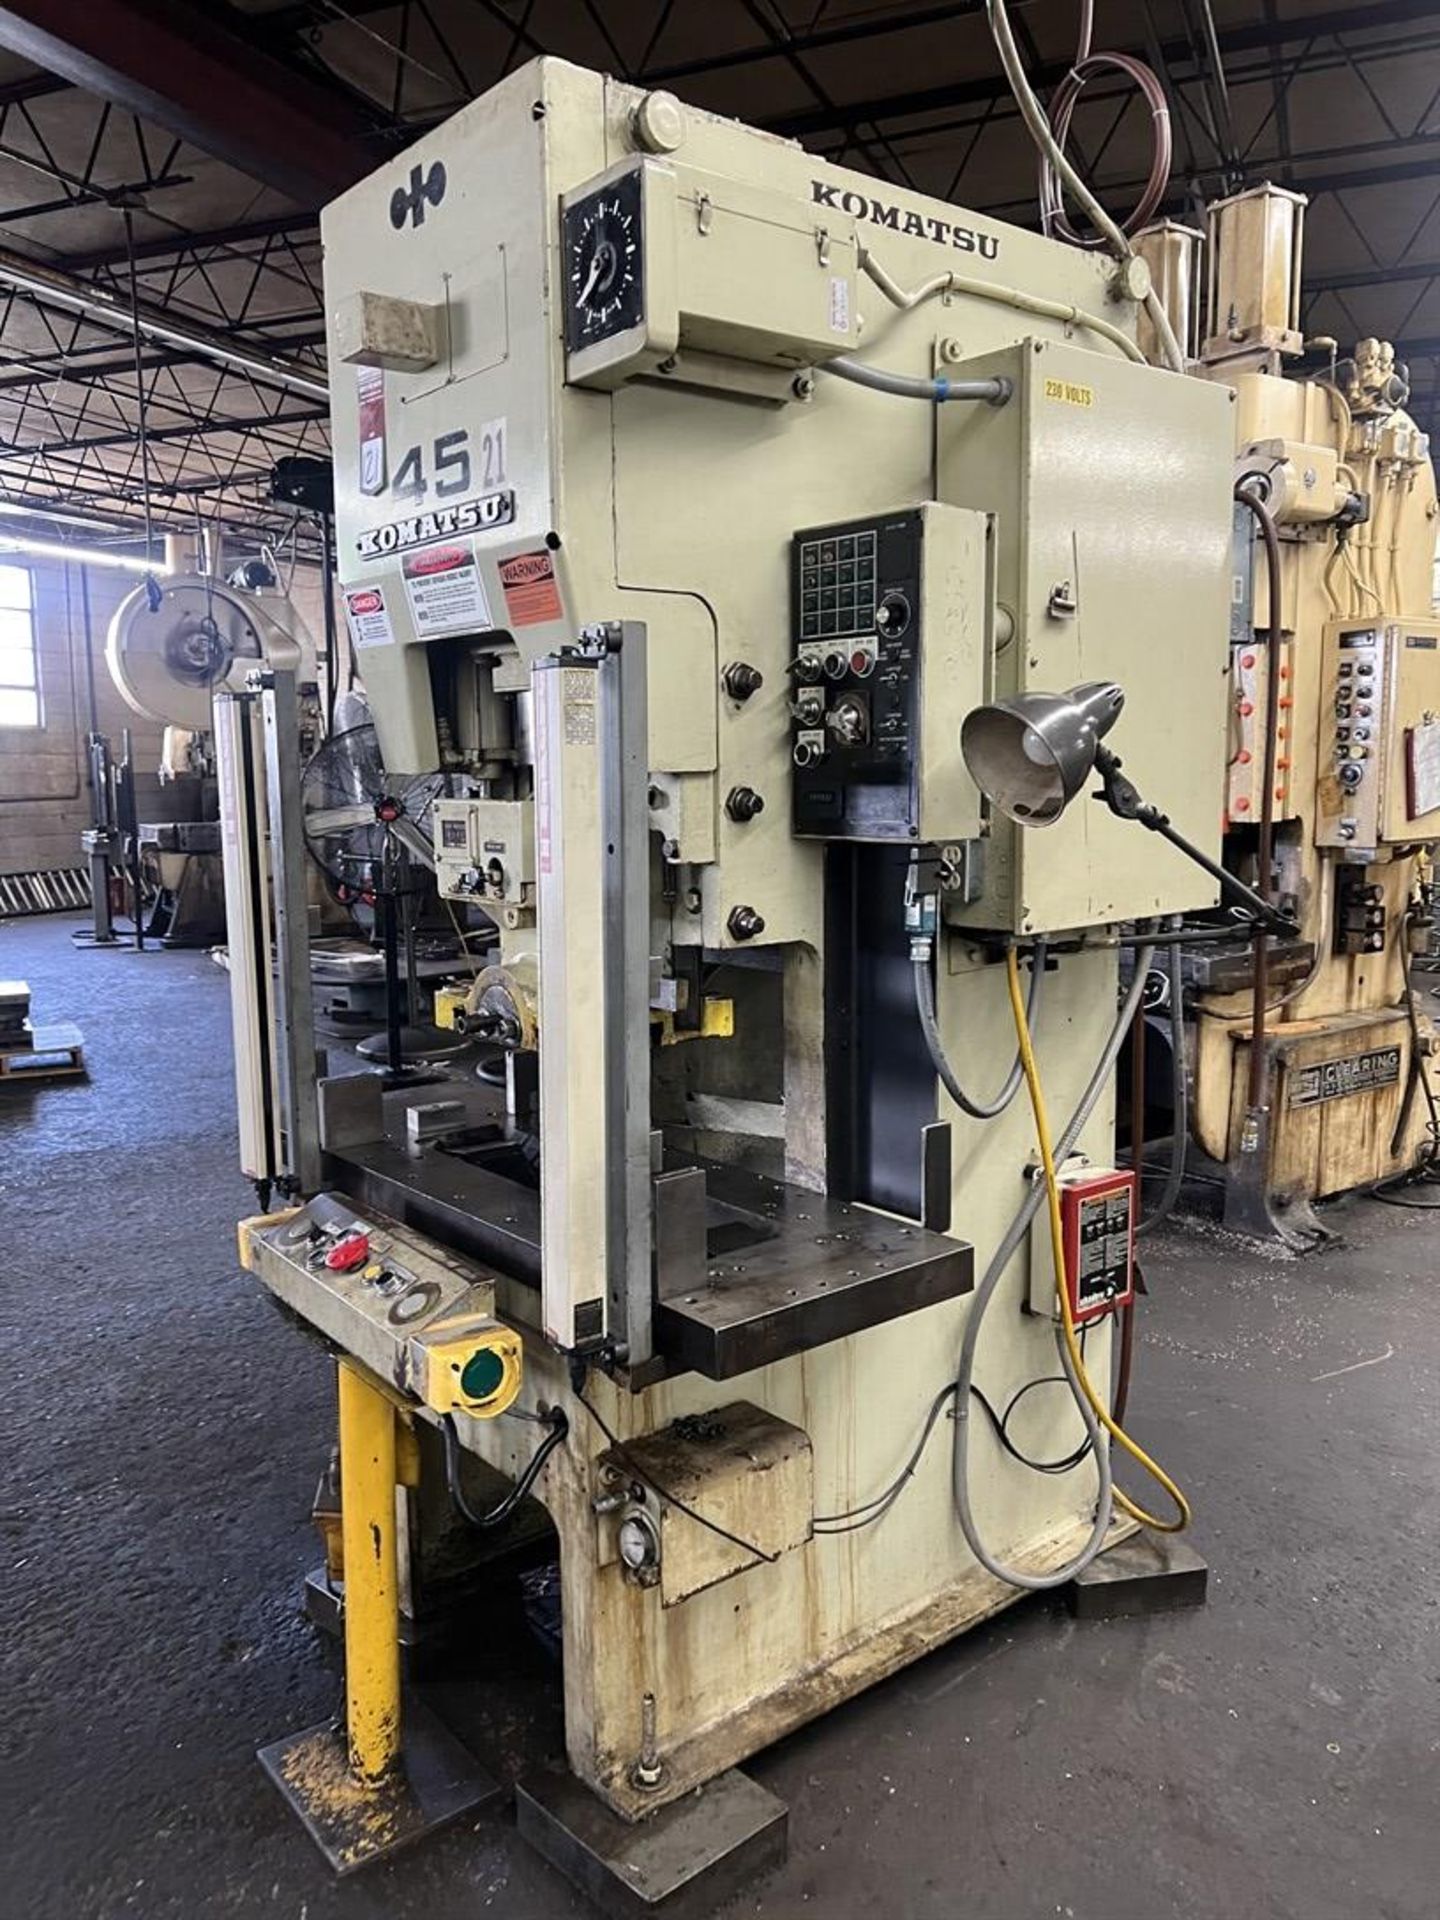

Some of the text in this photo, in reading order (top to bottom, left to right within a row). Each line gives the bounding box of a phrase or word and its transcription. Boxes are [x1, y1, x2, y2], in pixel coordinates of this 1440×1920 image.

[812, 181, 999, 260] KOMATSU
[1046, 380, 1091, 405] 230 VOLTS
[392, 429, 471, 506] 45
[482, 428, 506, 488] 21
[360, 494, 501, 554] KOMATSU
[503, 558, 549, 581] WARNING
[1325, 1052, 1399, 1081] CLEARING
